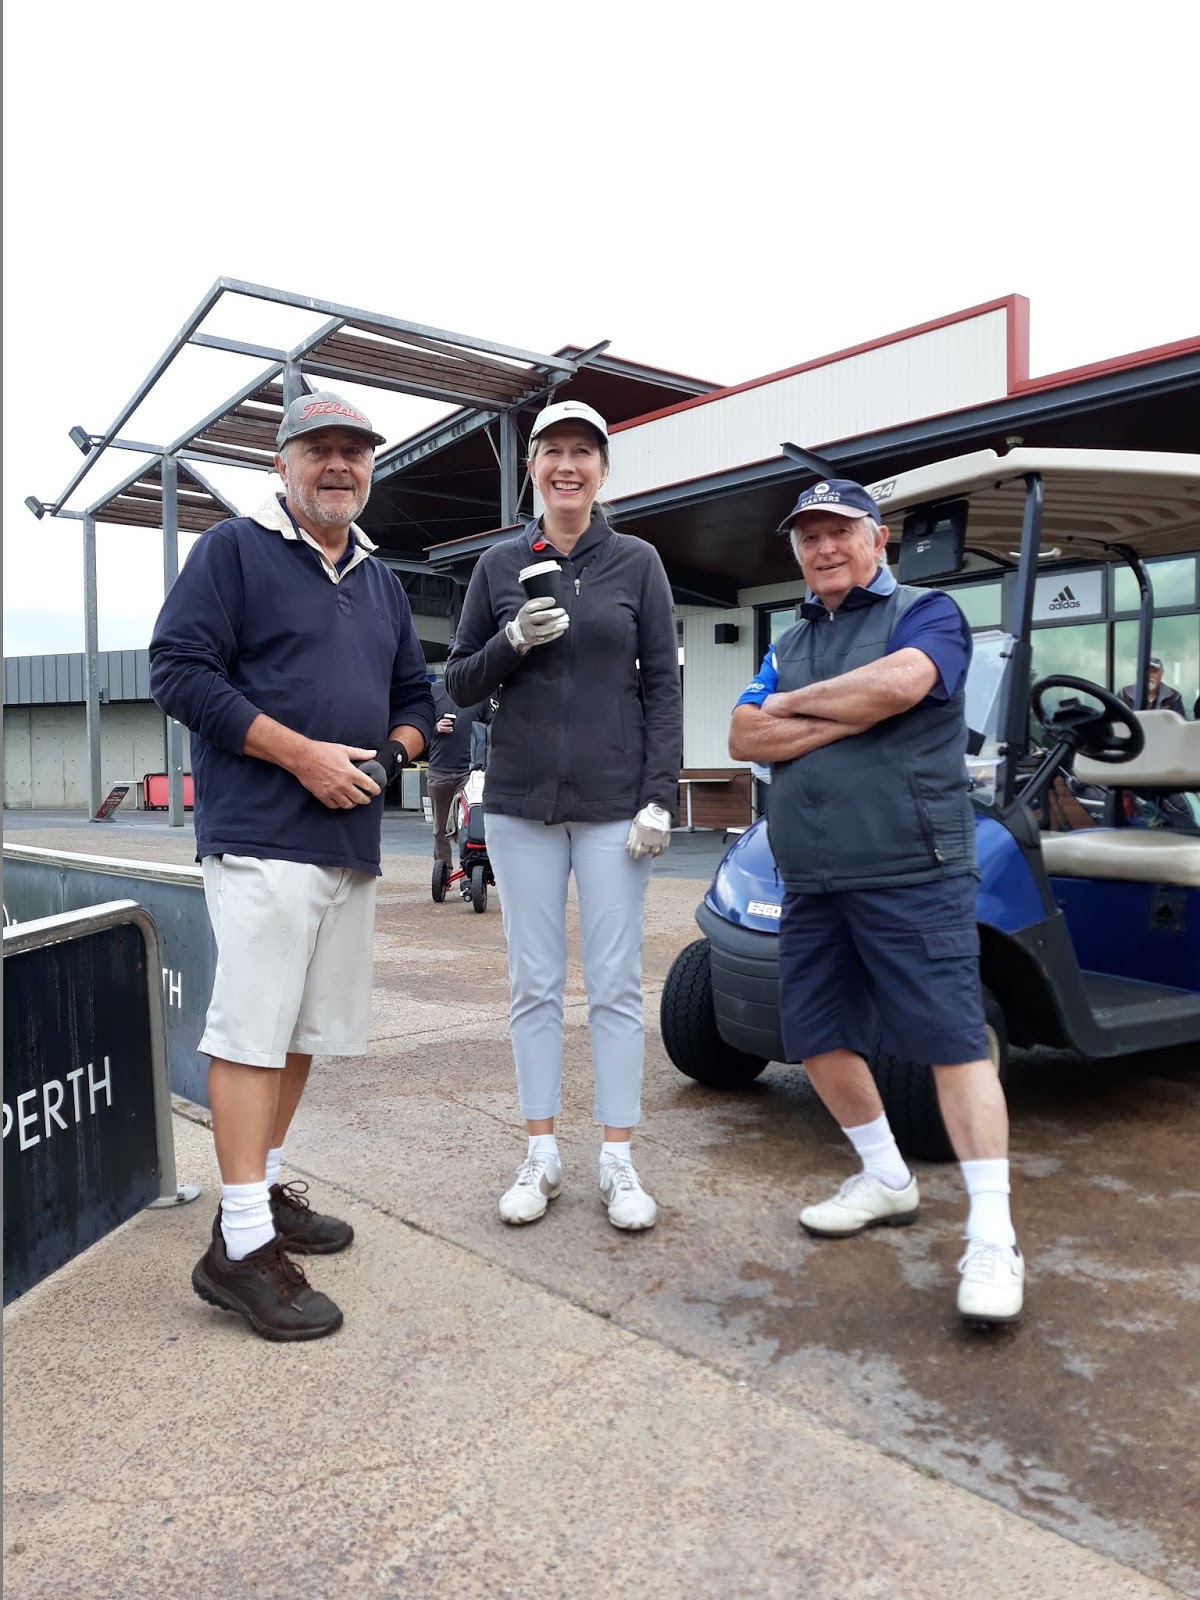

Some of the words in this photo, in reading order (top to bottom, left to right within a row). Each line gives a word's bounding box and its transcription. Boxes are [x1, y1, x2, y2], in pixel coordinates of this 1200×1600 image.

[871, 480, 897, 501] 24
[800, 495, 840, 508] MASTERS
[1048, 600, 1081, 611] adidas
